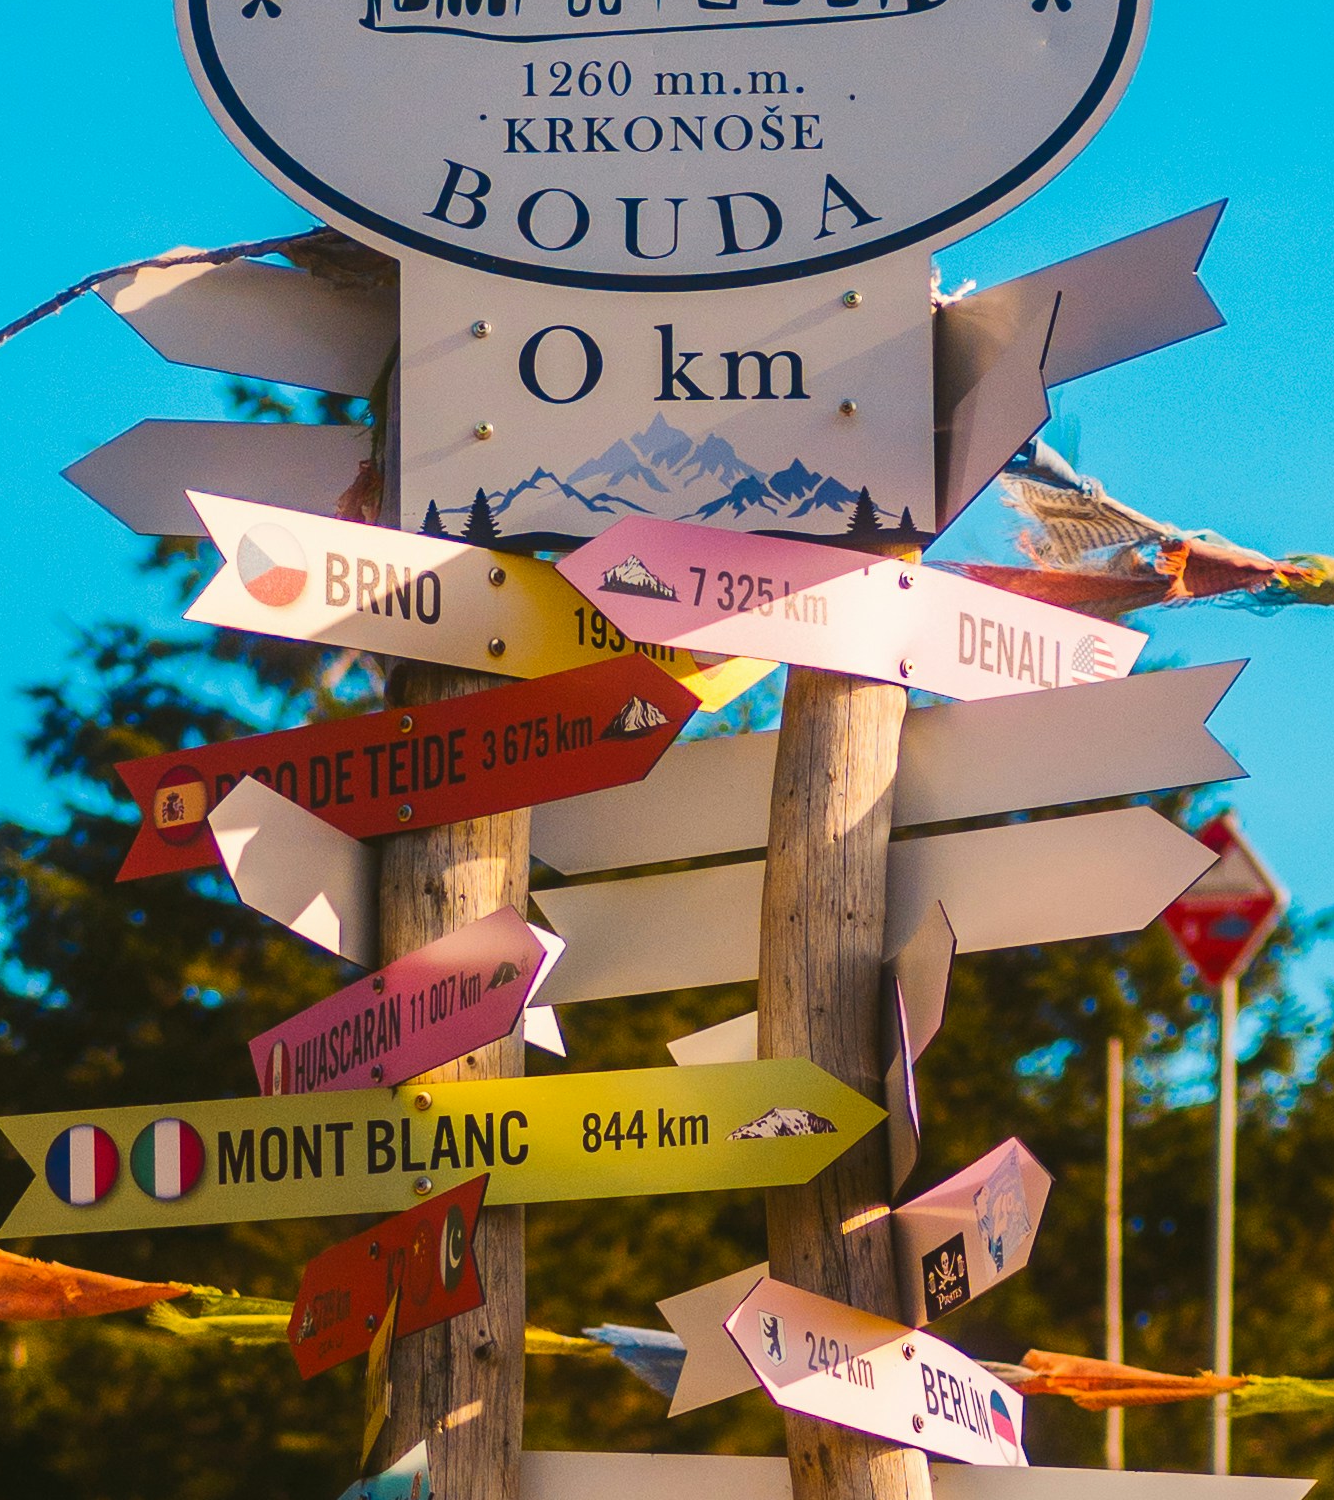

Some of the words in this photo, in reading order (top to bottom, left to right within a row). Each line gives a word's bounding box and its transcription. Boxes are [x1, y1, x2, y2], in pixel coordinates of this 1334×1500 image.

[521, 60, 633, 97] 1260
[502, 105, 824, 154] KRKONOŠE
[422, 158, 882, 260] BOUDA
[654, 323, 812, 401] km
[325, 551, 442, 626] BRNO
[688, 566, 707, 607] 7
[716, 571, 775, 618] 325
[783, 581, 829, 627] km
[958, 610, 1061, 689] DENALI
[310, 750, 355, 809] DE
[362, 728, 467, 799] TEIDE
[481, 730, 497, 771] 3
[503, 717, 550, 765] 675
[556, 713, 593, 755] km
[294, 993, 401, 1094] HUASCARAN
[410, 990, 425, 1033] 11
[429, 974, 457, 1024] 007
[459, 971, 481, 1011] km
[217, 1120, 354, 1185] MONT
[367, 1110, 529, 1174] BLANC
[582, 1110, 648, 1153] 844
[658, 1107, 710, 1148] km
[805, 1330, 842, 1380] 242
[845, 1343, 875, 1390] km
